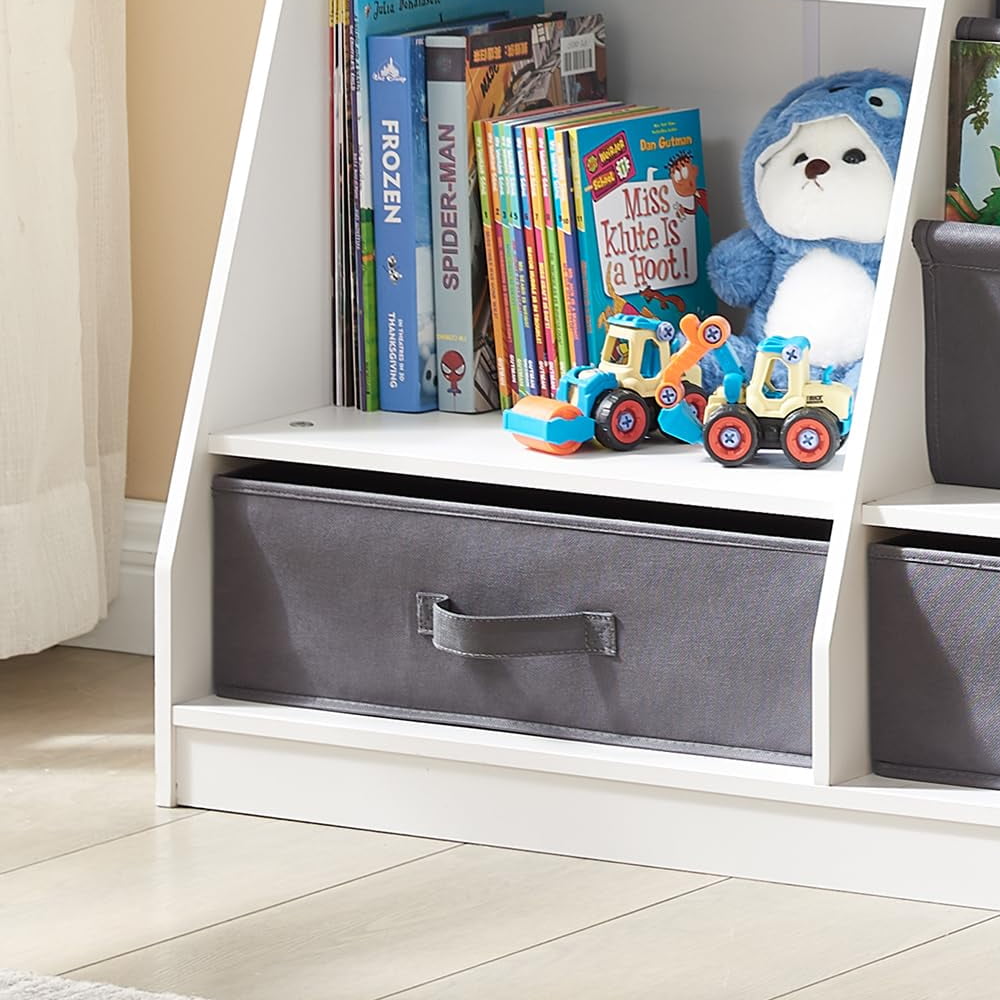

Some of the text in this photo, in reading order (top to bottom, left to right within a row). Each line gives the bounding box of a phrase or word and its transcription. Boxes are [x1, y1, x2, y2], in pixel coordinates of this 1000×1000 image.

[373, 1, 395, 20] Julia
[640, 136, 692, 152] Dan Gutman
[382, 119, 402, 224] FROZEN
[438, 123, 459, 291] SPIDER-MAN
[622, 184, 670, 220] Miss
[601, 216, 681, 258] Klute Is
[612, 244, 692, 291] a Hoot!
[388, 312, 398, 388] THANKSGIVING
[548, 360, 556, 390] GUTMAN
